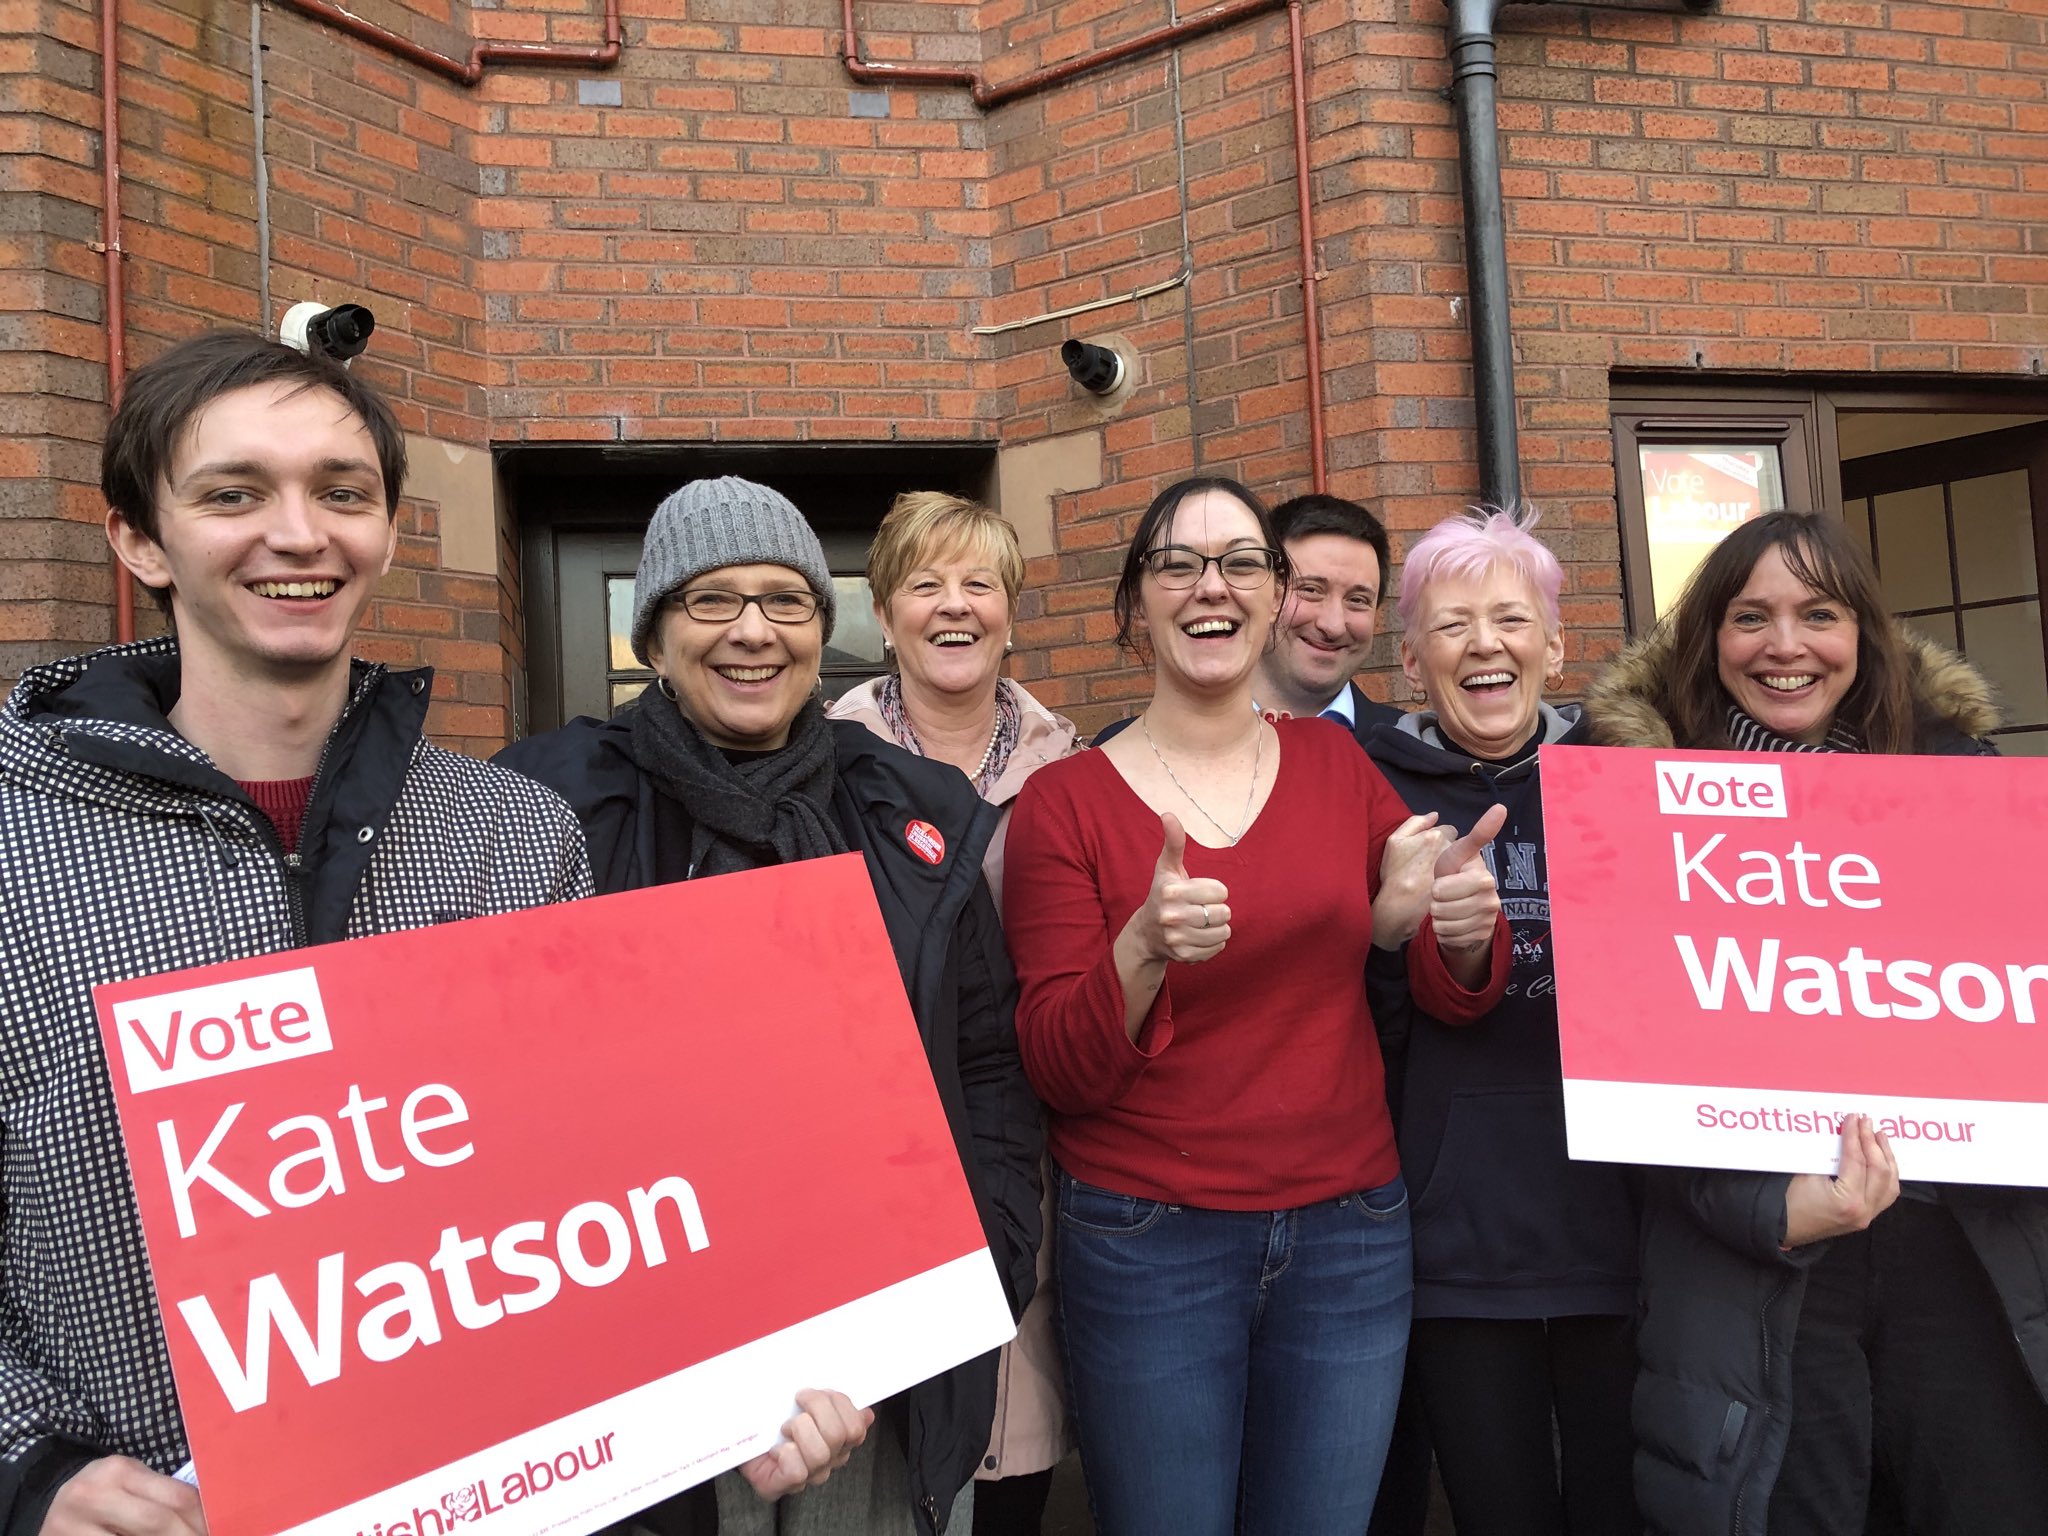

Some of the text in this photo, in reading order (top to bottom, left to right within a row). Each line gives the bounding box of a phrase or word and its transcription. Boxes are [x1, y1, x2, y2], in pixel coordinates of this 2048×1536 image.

[1650, 468, 1705, 495] Vote
[1663, 771, 1775, 809] Vote
[1672, 831, 1882, 909] Kate
[1511, 942, 1544, 955] ASA
[127, 1001, 313, 1072] Vote
[1695, 1102, 1977, 1144] Scottish abour
[156, 1083, 476, 1239] Kate
[176, 1176, 710, 1414] Watson
[477, 1431, 616, 1517] Labour
